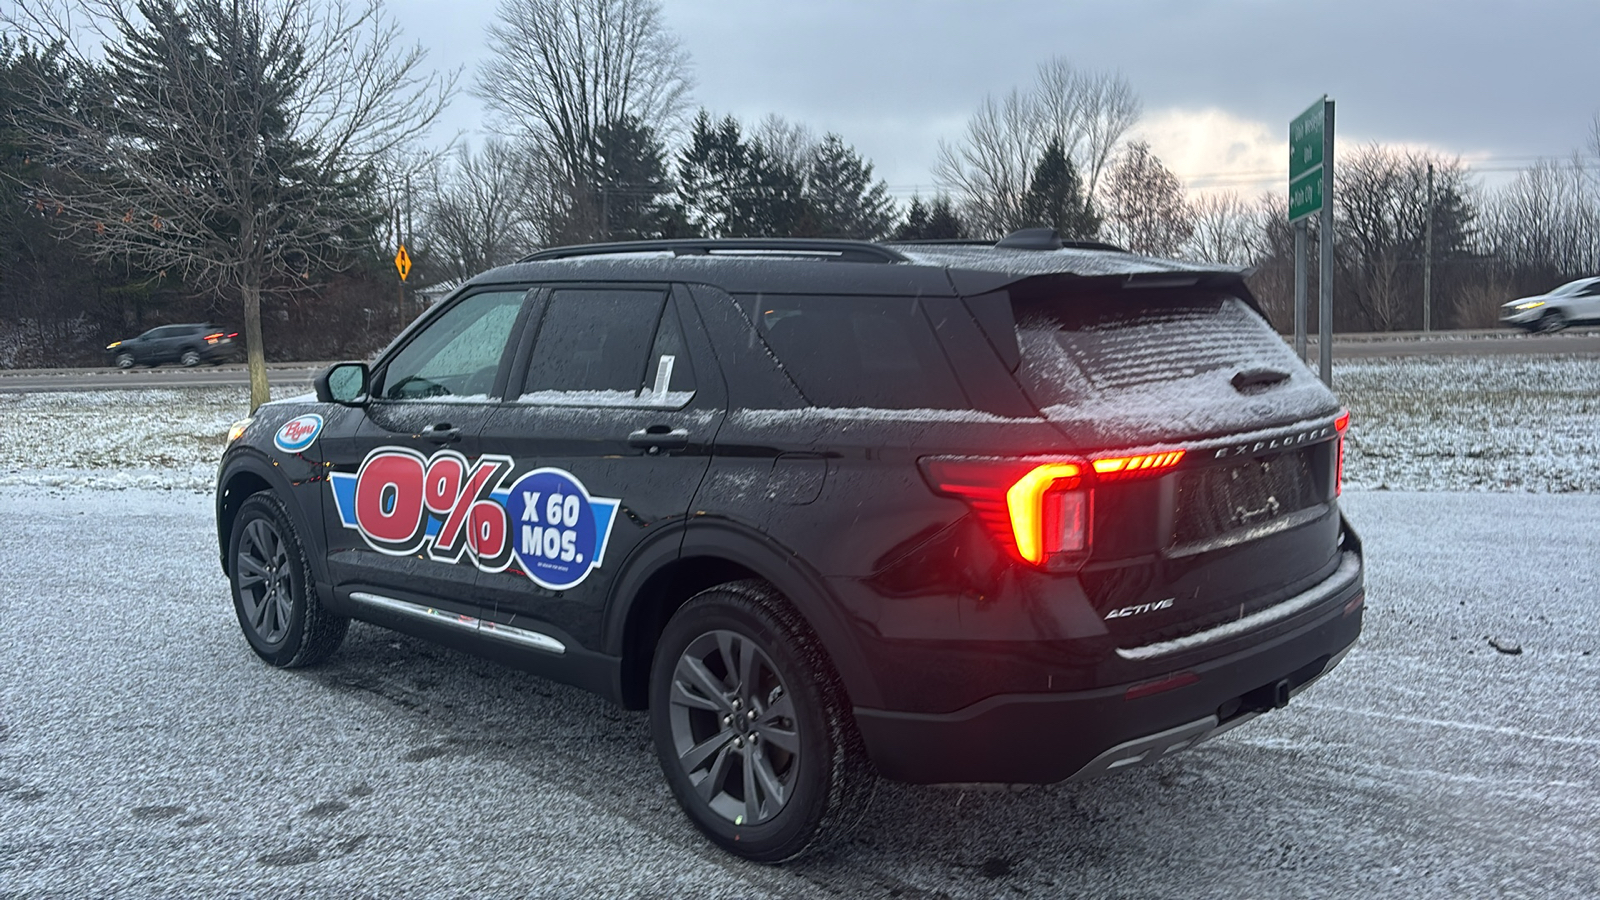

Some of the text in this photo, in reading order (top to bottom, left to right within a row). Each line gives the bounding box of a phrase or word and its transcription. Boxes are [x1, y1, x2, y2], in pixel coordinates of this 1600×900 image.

[1214, 428, 1330, 459] EXPLORER
[355, 447, 513, 570] 0%
[521, 491, 580, 527] X 60
[521, 525, 584, 564] MOS.
[1104, 598, 1175, 621] ACTIVE
